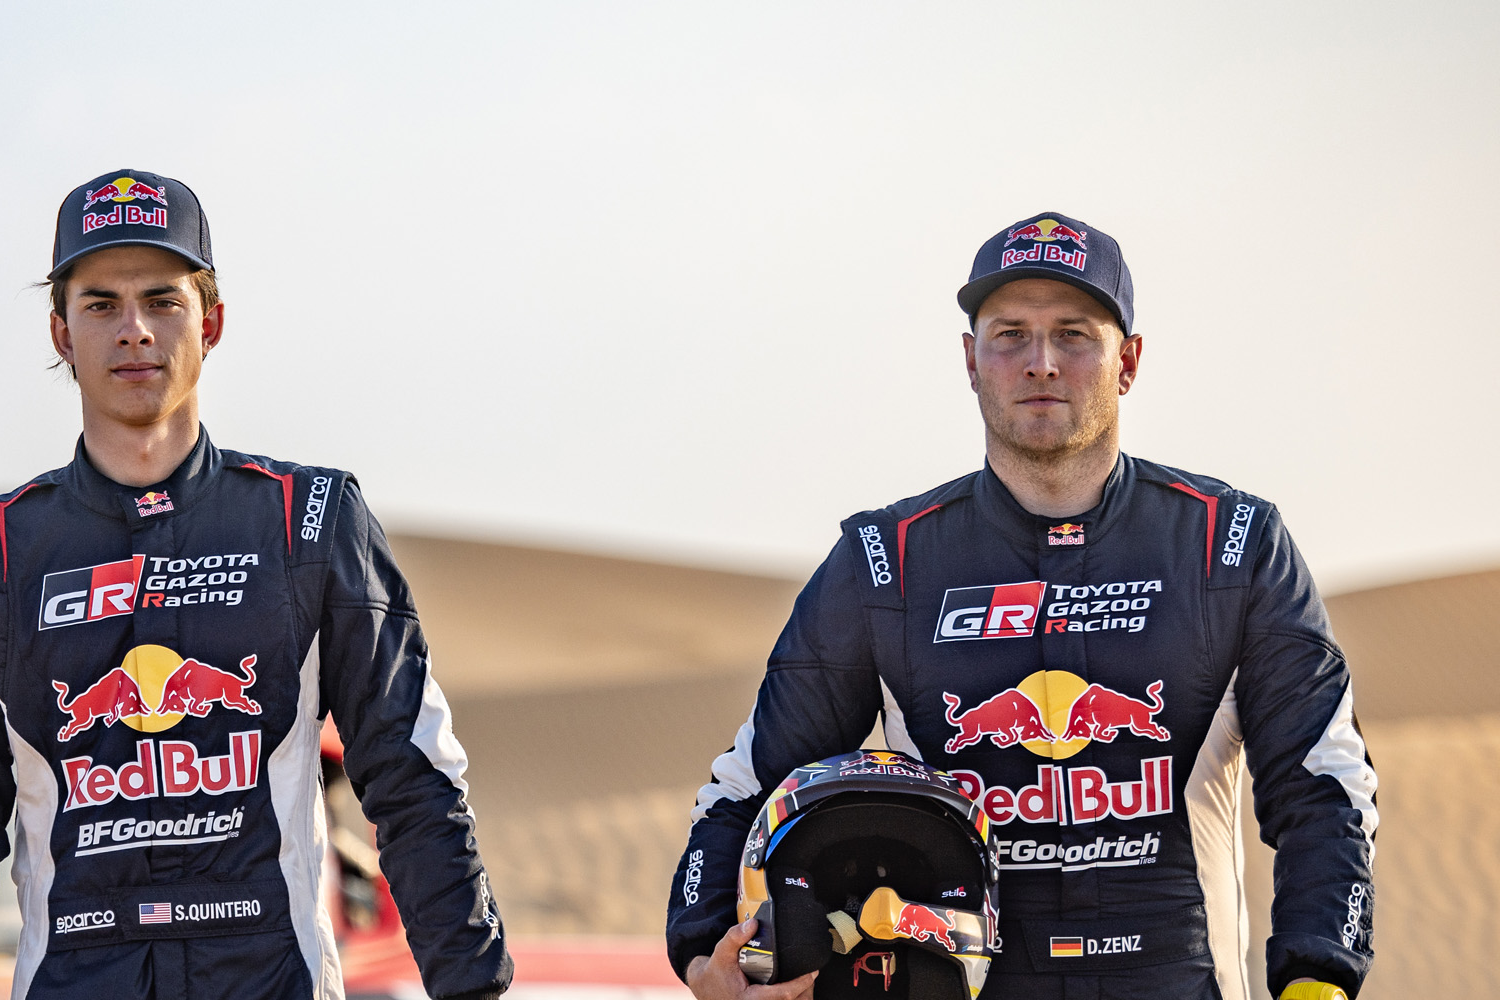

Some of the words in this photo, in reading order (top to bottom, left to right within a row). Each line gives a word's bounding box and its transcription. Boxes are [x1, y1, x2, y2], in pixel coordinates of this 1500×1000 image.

[83, 205, 122, 235] Red
[125, 205, 168, 229] Bull
[1001, 243, 1042, 270] Red
[1044, 244, 1087, 272] Bull
[138, 505, 157, 517] Red
[157, 501, 174, 513] Bull
[301, 476, 332, 543] sparco
[1048, 535, 1066, 546] Red
[1067, 534, 1085, 545] Bull
[1221, 503, 1255, 567] sparco
[858, 524, 892, 588] sparco
[43, 582, 135, 625] GR
[141, 588, 244, 608] Racing
[940, 604, 1036, 638] GR
[1044, 614, 1146, 634] Racing
[61, 738, 160, 814] Red
[159, 729, 262, 797] Bull
[1067, 755, 1173, 825] Bull
[77, 808, 243, 848] BFGoodrich
[997, 833, 1159, 863] FGoodrich
[1139, 856, 1157, 865] Tires
[683, 849, 704, 907] sparco
[55, 910, 115, 934] sparco
[174, 900, 261, 922] S.QUINTERO
[1343, 883, 1366, 951] sparco
[1087, 934, 1142, 955] D.ZENZ
